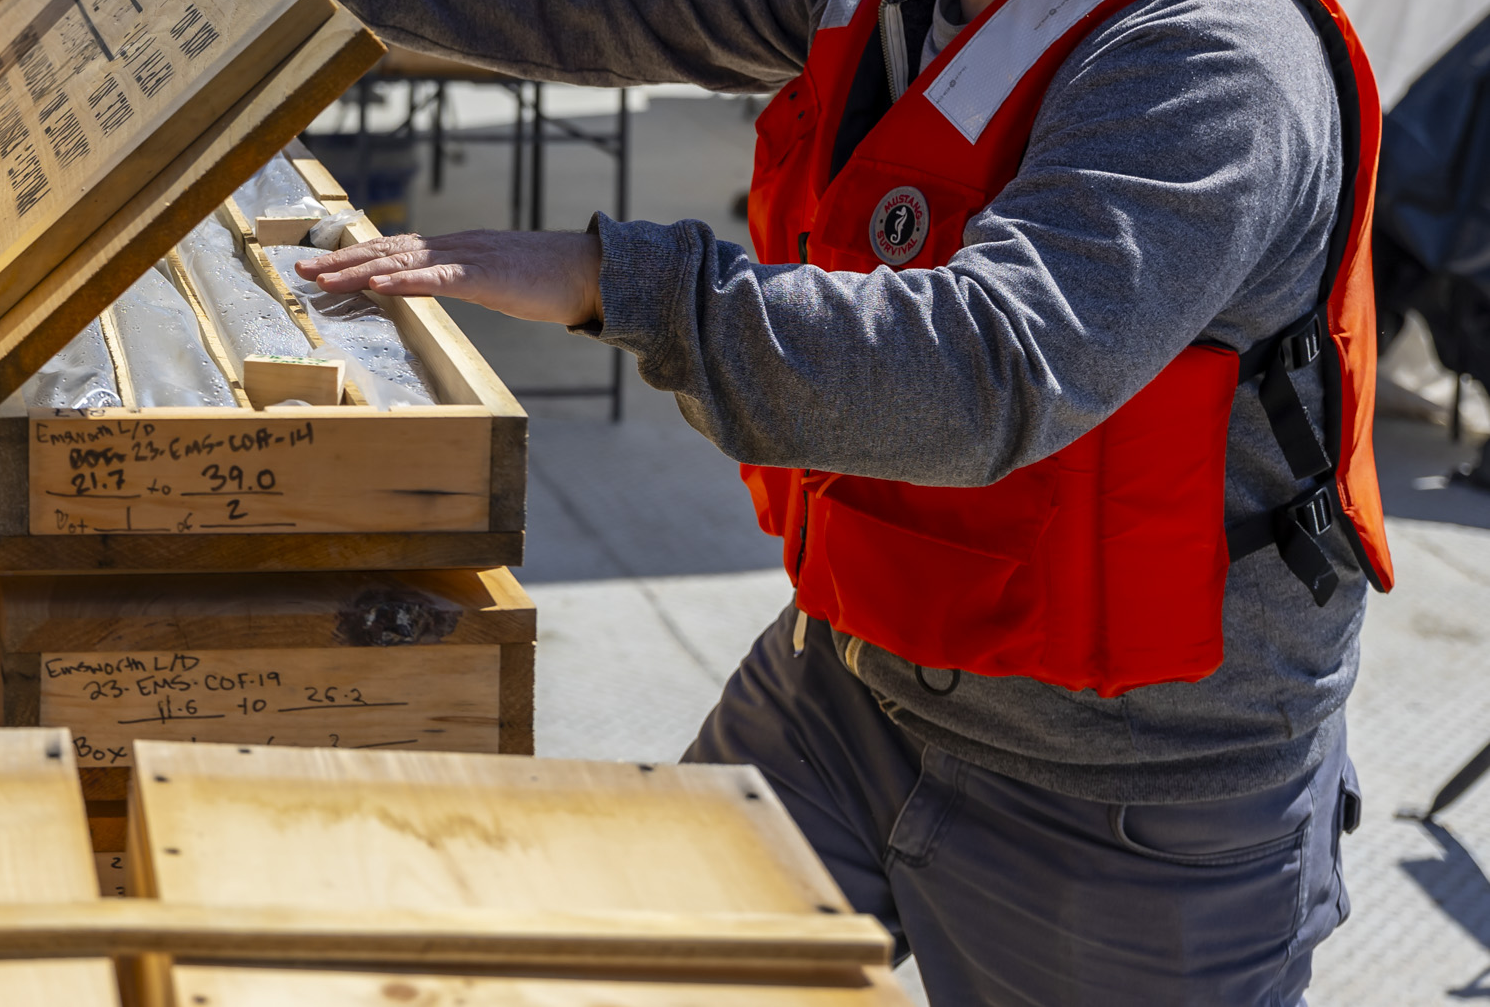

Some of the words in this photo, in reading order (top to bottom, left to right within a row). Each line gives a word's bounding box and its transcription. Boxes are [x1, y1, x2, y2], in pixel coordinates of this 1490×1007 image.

[170, 3, 203, 40] NO.
[179, 20, 220, 61] BOX
[87, 72, 118, 109] NO.
[132, 48, 175, 99] DEPTH
[38, 88, 69, 124] NO.
[94, 91, 134, 137] HOLE
[8, 143, 51, 216] PROJECT:
[884, 194, 923, 220] MUSTANG
[877, 230, 918, 256] SURVIVAL
[71, 469, 126, 495] 21.7
[146, 478, 171, 496] to
[201, 464, 276, 492] 39.0
[226, 499, 248, 520] 2
[154, 653, 200, 672] L/D
[158, 695, 198, 724] 11.6
[304, 686, 367, 706] 26.2
[73, 736, 128, 764] Box
